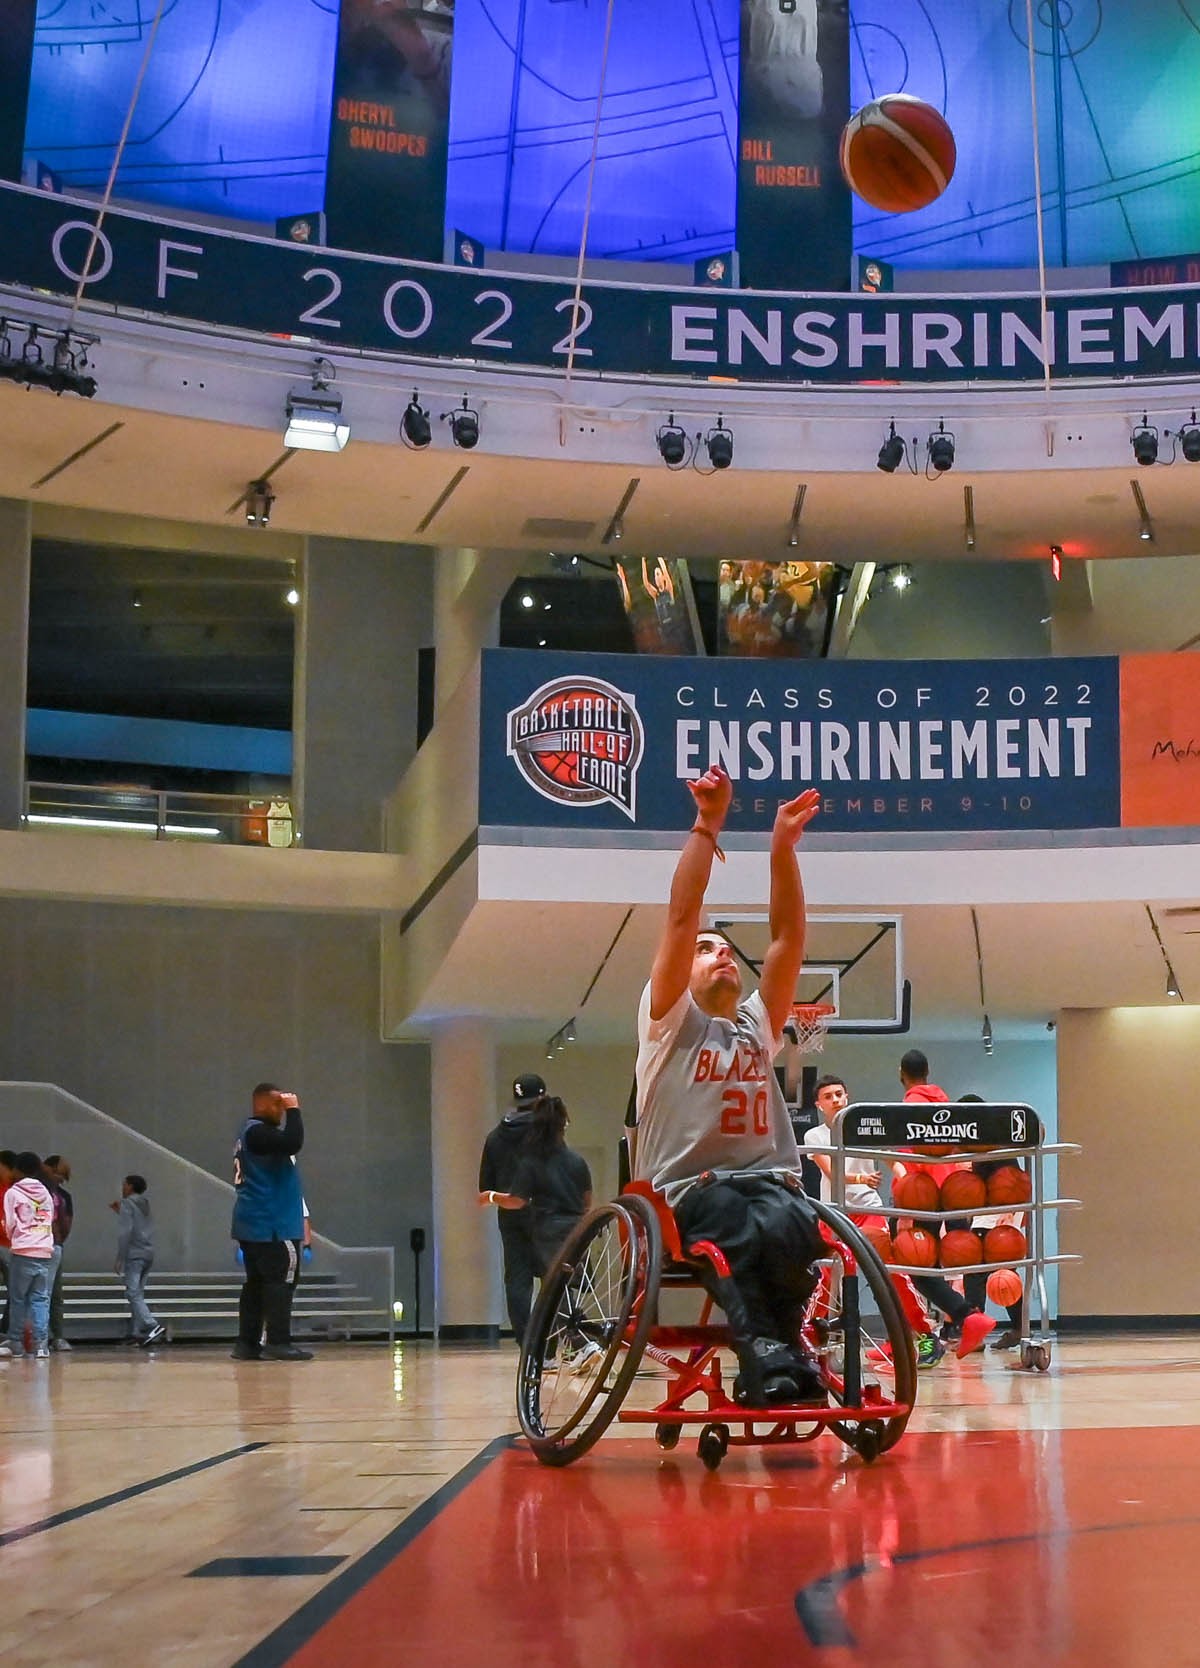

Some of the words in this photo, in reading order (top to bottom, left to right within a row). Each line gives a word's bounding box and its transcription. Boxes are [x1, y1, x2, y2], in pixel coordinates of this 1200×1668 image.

[742, 139, 775, 161] BILL
[755, 164, 821, 188] RUSSELL
[51, 220, 204, 299] OF
[299, 267, 594, 358] 2022
[676, 685, 833, 709] CLASS
[876, 687, 933, 709] OF
[975, 684, 1092, 707] 2022
[520, 698, 627, 737] BASKETBALL
[561, 731, 598, 755] HALL
[606, 734, 628, 761] OF
[675, 717, 1093, 781] ENSHRINEMENT
[581, 756, 627, 802] FAME
[720, 1088, 769, 1136] 20
[857, 1126, 872, 1136] GAME
[906, 1122, 980, 1140] SPALDING
